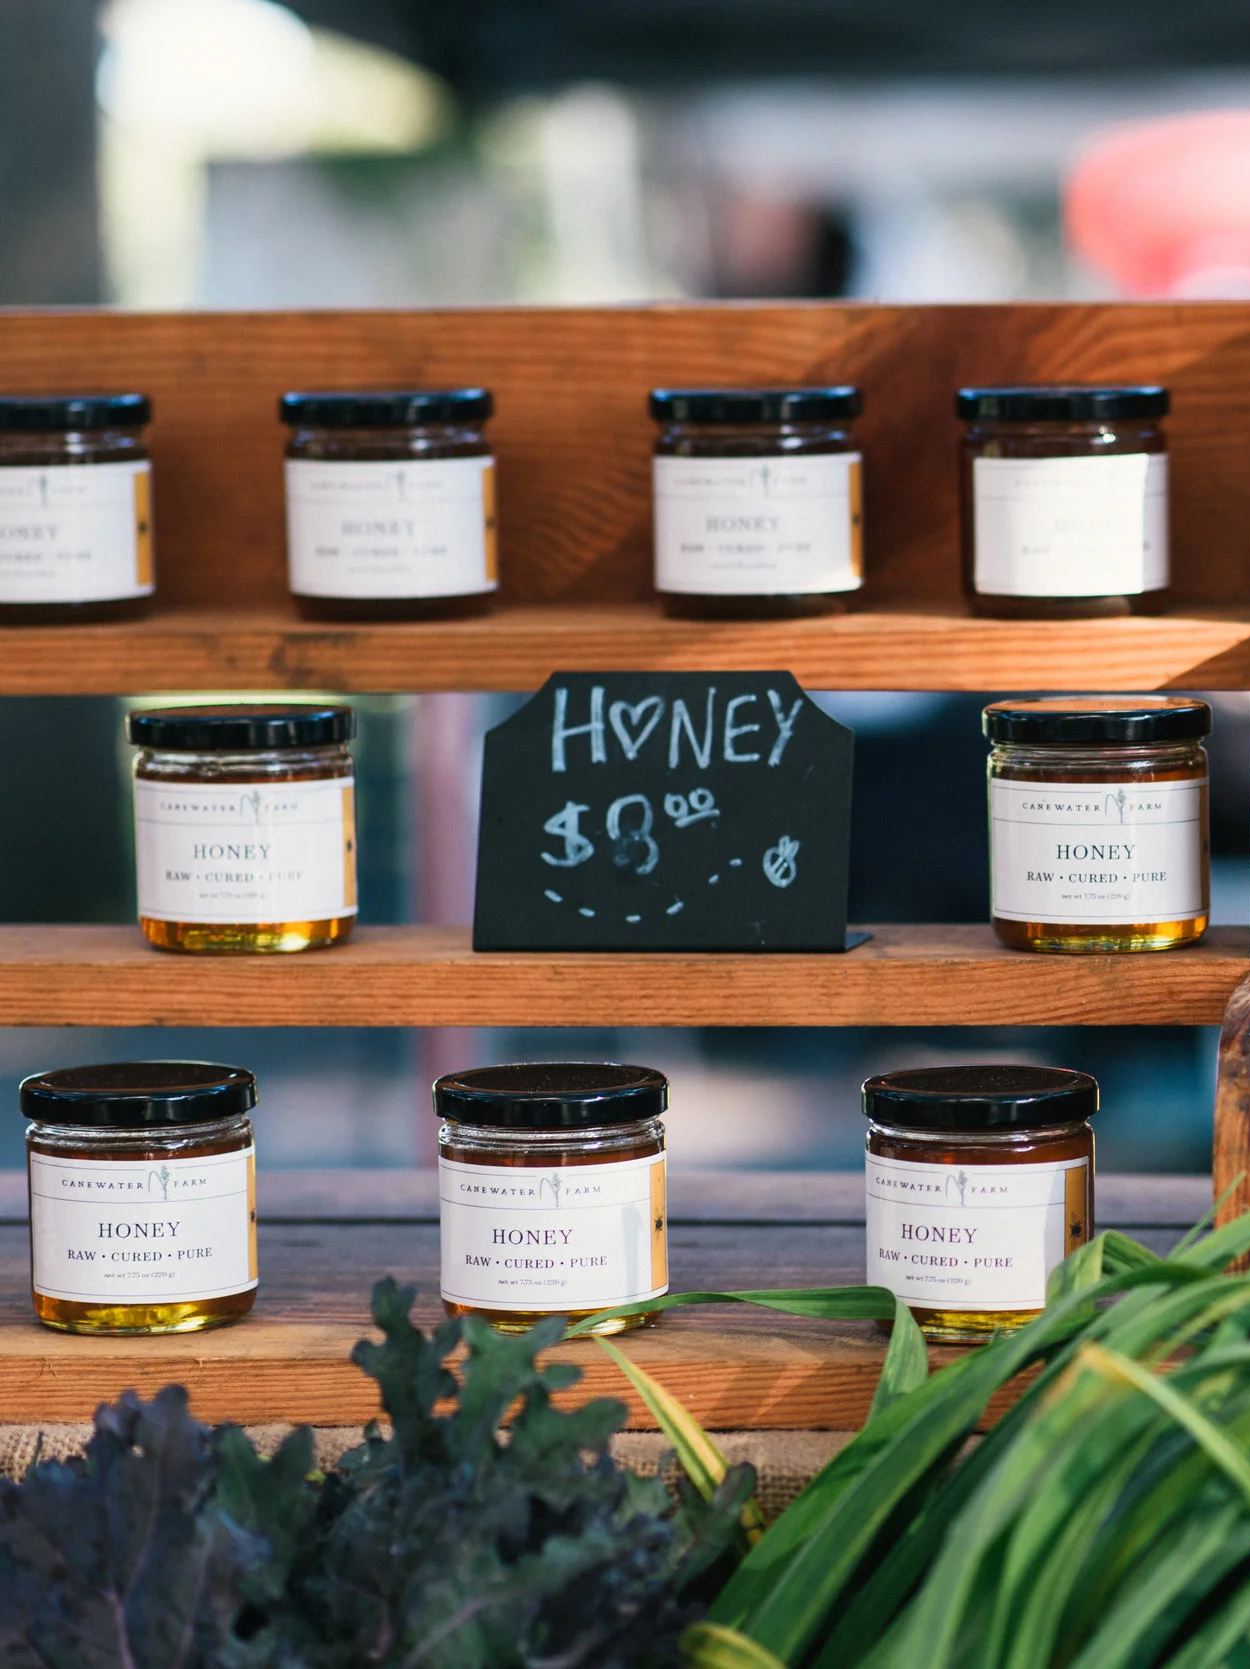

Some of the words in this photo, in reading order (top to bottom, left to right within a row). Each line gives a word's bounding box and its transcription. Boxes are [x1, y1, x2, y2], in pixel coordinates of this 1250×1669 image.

[706, 516, 780, 533] HONEY
[1022, 802, 1101, 812] CANEWATER
[1130, 803, 1163, 811] FARM
[193, 844, 271, 860] HONEY
[1056, 844, 1137, 860] HONEY
[166, 870, 192, 882] RAW
[205, 873, 255, 884] CURED
[1027, 872, 1055, 882] RAW
[1068, 873, 1118, 884] CURED
[1132, 871, 1167, 882] PURE
[62, 1179, 144, 1190] CANEWATER
[173, 1178, 207, 1188] FARM
[460, 1183, 536, 1196] CANEWATER
[566, 1186, 601, 1195] FARM
[876, 1176, 942, 1192] CANEWATER
[971, 1186, 1009, 1194] FARM
[98, 1221, 181, 1238] HONEY
[492, 1228, 573, 1245] HONEY
[901, 1223, 978, 1244] HONEY
[67, 1249, 97, 1261] RAW
[111, 1252, 162, 1262] CURED
[177, 1247, 213, 1260] PURE
[465, 1254, 491, 1267] RAW
[504, 1258, 555, 1269] CURED
[570, 1256, 608, 1268] PURE
[879, 1248, 900, 1261] RAW
[911, 1254, 958, 1267] CURED
[974, 1257, 1013, 1268] PURE
